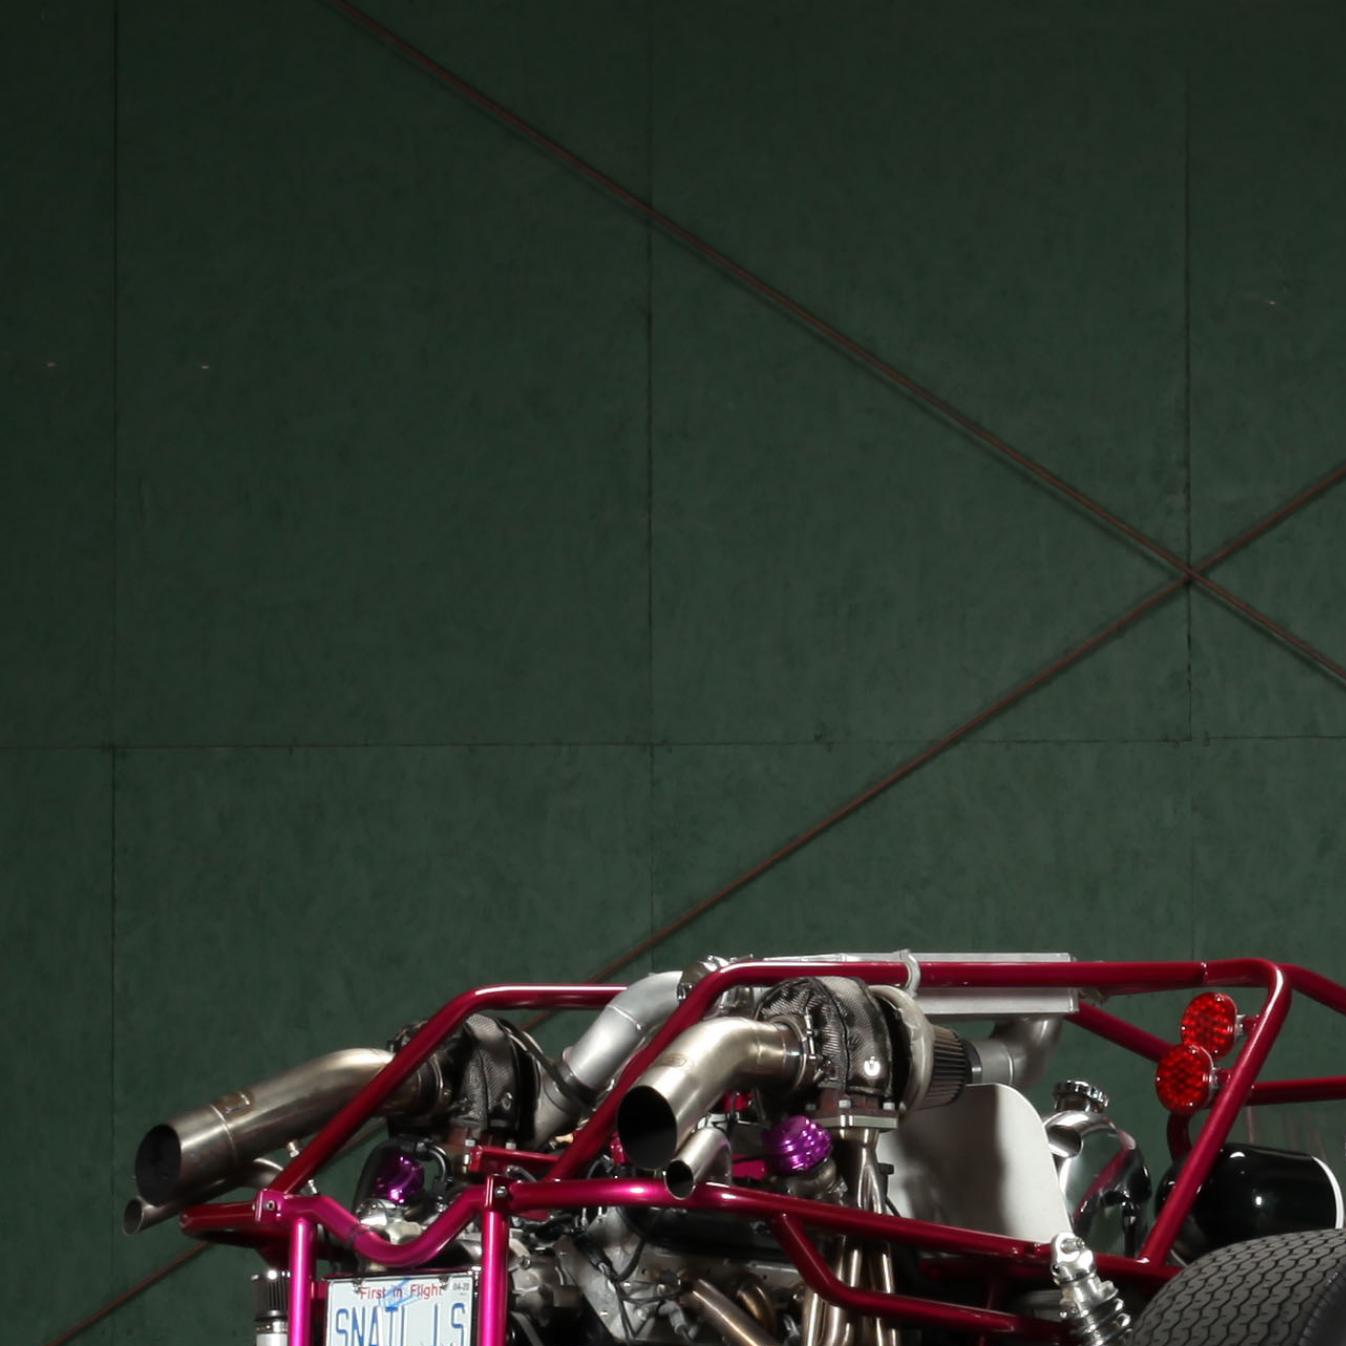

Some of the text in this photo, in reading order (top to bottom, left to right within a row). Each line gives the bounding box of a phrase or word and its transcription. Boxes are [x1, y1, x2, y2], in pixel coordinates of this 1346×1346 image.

[359, 1283, 443, 1300] First in Flight
